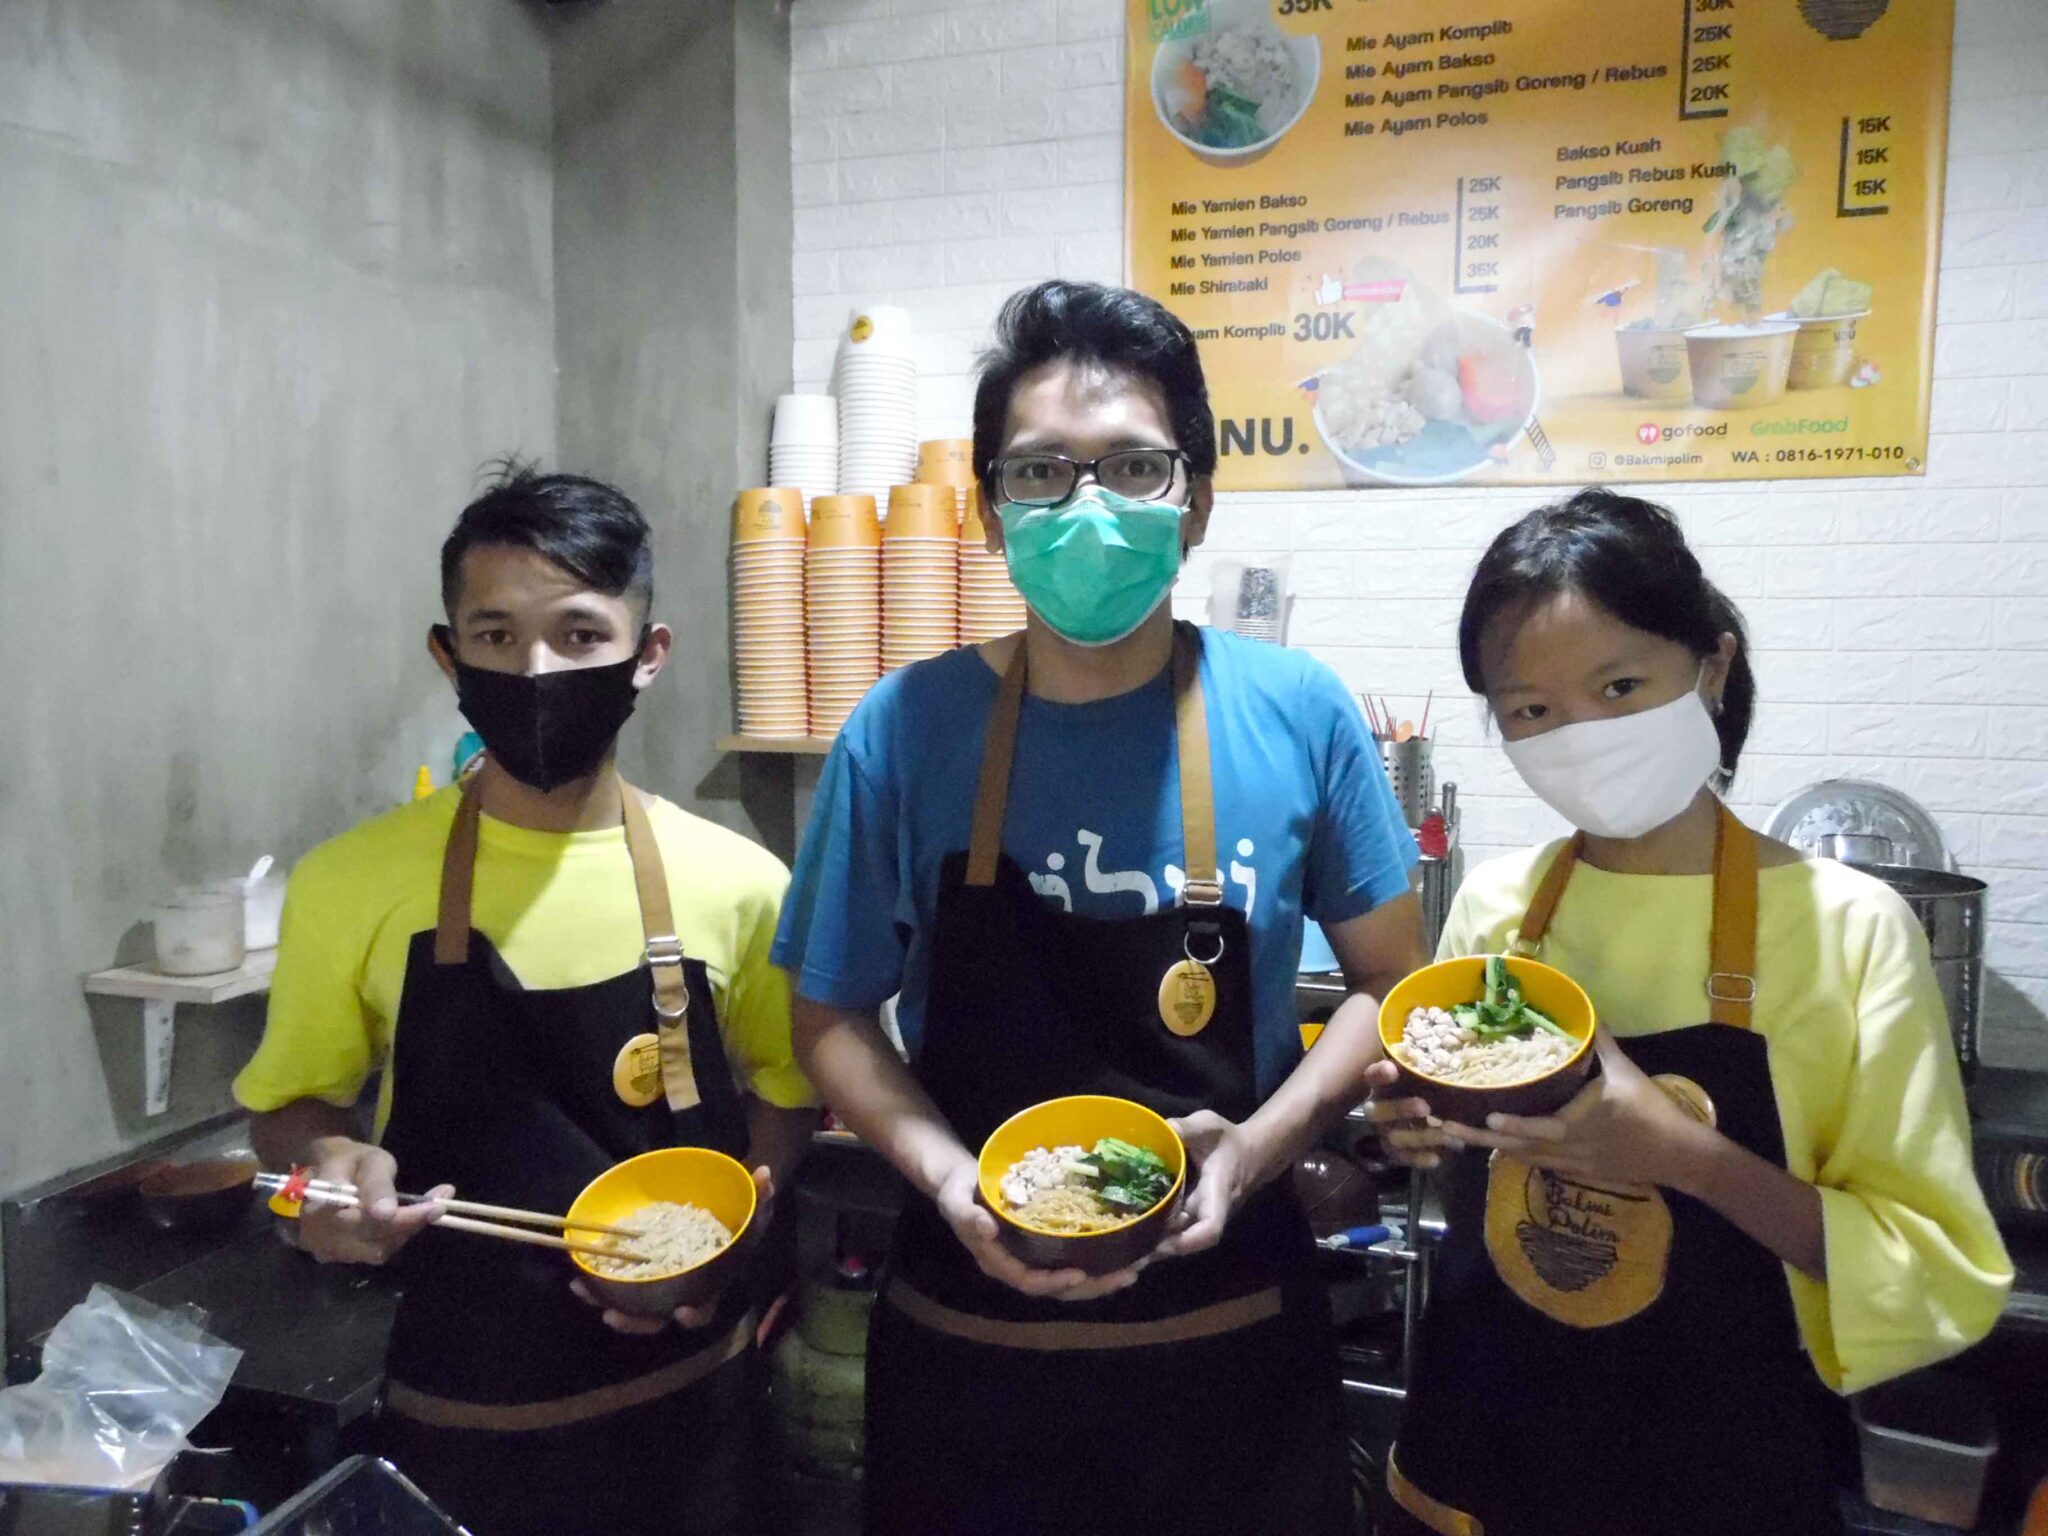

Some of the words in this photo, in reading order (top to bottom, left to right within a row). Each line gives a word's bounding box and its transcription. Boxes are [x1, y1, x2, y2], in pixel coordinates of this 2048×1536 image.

[1346, 36, 1377, 52] Mie
[1383, 32, 1434, 50] Ayam
[1439, 20, 1512, 41] Komplit
[1693, 24, 1733, 43] 25K
[1346, 64, 1376, 79] Mie
[1382, 59, 1433, 78] Ayam
[1438, 53, 1495, 70] Bakso
[1692, 54, 1731, 73] 25K
[1345, 92, 1375, 108] Mie
[1381, 88, 1432, 107] Ayam
[1437, 78, 1509, 100] Pangsit
[1515, 72, 1586, 92] Goreng
[1605, 64, 1668, 83] Rebus
[1690, 83, 1729, 102] 20K
[1345, 121, 1374, 136] Mie
[1380, 117, 1431, 135] Ayam
[1437, 111, 1488, 128] Polos
[1857, 115, 1891, 134] 15K
[1556, 145, 1610, 161] Bakso
[1616, 138, 1662, 155] Kuah
[1856, 147, 1889, 165] 15K
[1468, 176, 1502, 193] 25K
[1555, 170, 1623, 191] Pangsit
[1628, 165, 1685, 183] Rebus
[1690, 161, 1737, 180] Kuah
[1853, 179, 1887, 196] 15K
[1171, 201, 1197, 215] Mie
[1202, 198, 1255, 213] Yamien
[1260, 194, 1308, 209] Bakso
[1467, 205, 1500, 222] 25K
[1627, 197, 1694, 214] Goreng
[1171, 228, 1196, 242] Mie
[1201, 225, 1254, 240] Yamien
[1259, 219, 1319, 238] Pangsit
[1324, 216, 1383, 232] Goreng
[1398, 211, 1450, 226] Rebus
[1467, 234, 1499, 250] 20K
[1171, 255, 1196, 269] Mie
[1201, 253, 1254, 267] Yamien
[1259, 249, 1301, 263] Polos
[1467, 261, 1499, 278] 35K
[1170, 282, 1195, 296] Mie
[1200, 276, 1268, 294] Shirataki
[1191, 328, 1219, 340] am
[1224, 323, 1286, 341] Komplit
[1293, 311, 1356, 342] 30K
[1661, 422, 1728, 441] gofood
[1751, 416, 1849, 436] GrabFood
[1220, 417, 1310, 457] NU.
[1732, 451, 1759, 463] WA
[1776, 446, 1904, 462] 0816-1971-010
